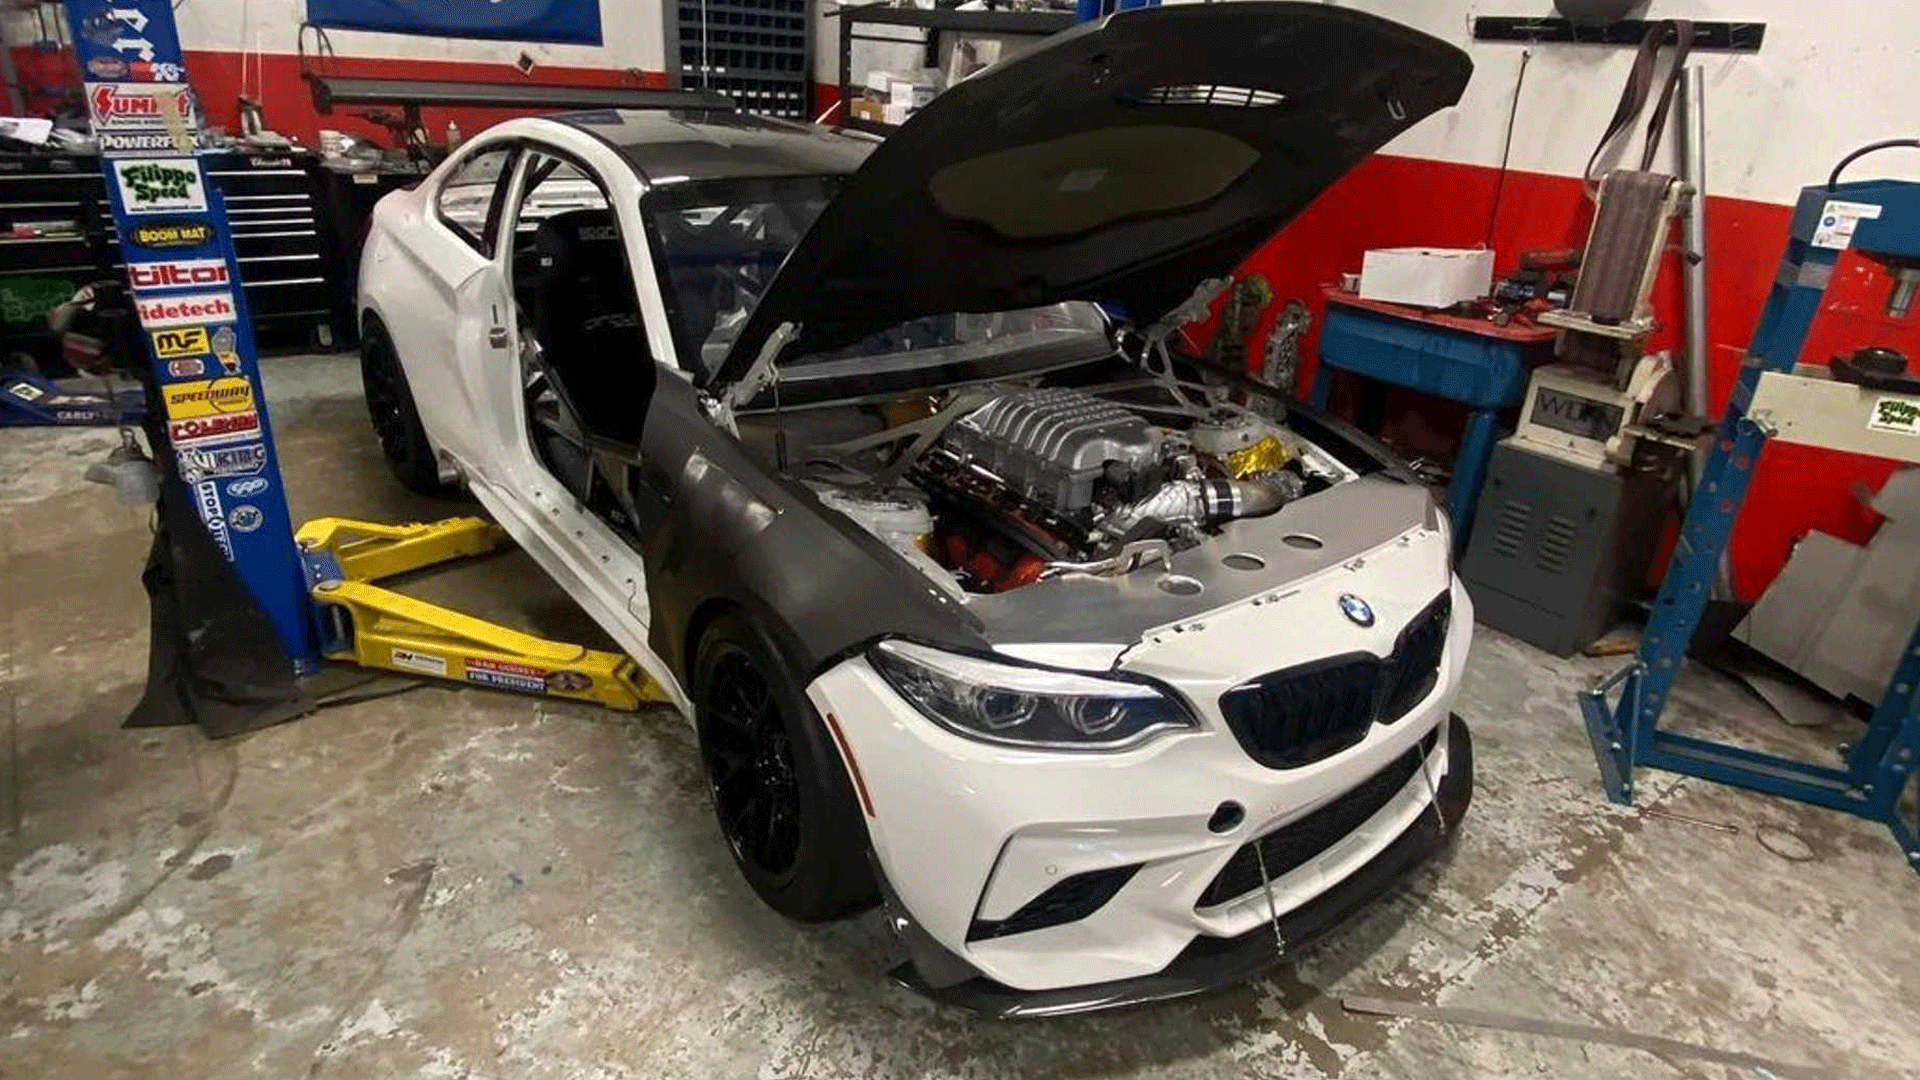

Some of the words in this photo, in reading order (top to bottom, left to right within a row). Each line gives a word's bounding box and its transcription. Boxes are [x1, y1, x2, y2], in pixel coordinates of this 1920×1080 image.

[92, 84, 191, 125] SUMT
[100, 135, 200, 150] POWERFX
[120, 164, 196, 188] Filippo
[135, 184, 190, 203] Speed
[139, 229, 179, 242] BOOM
[180, 227, 205, 240] MAT
[1878, 400, 1920, 417] Filipp
